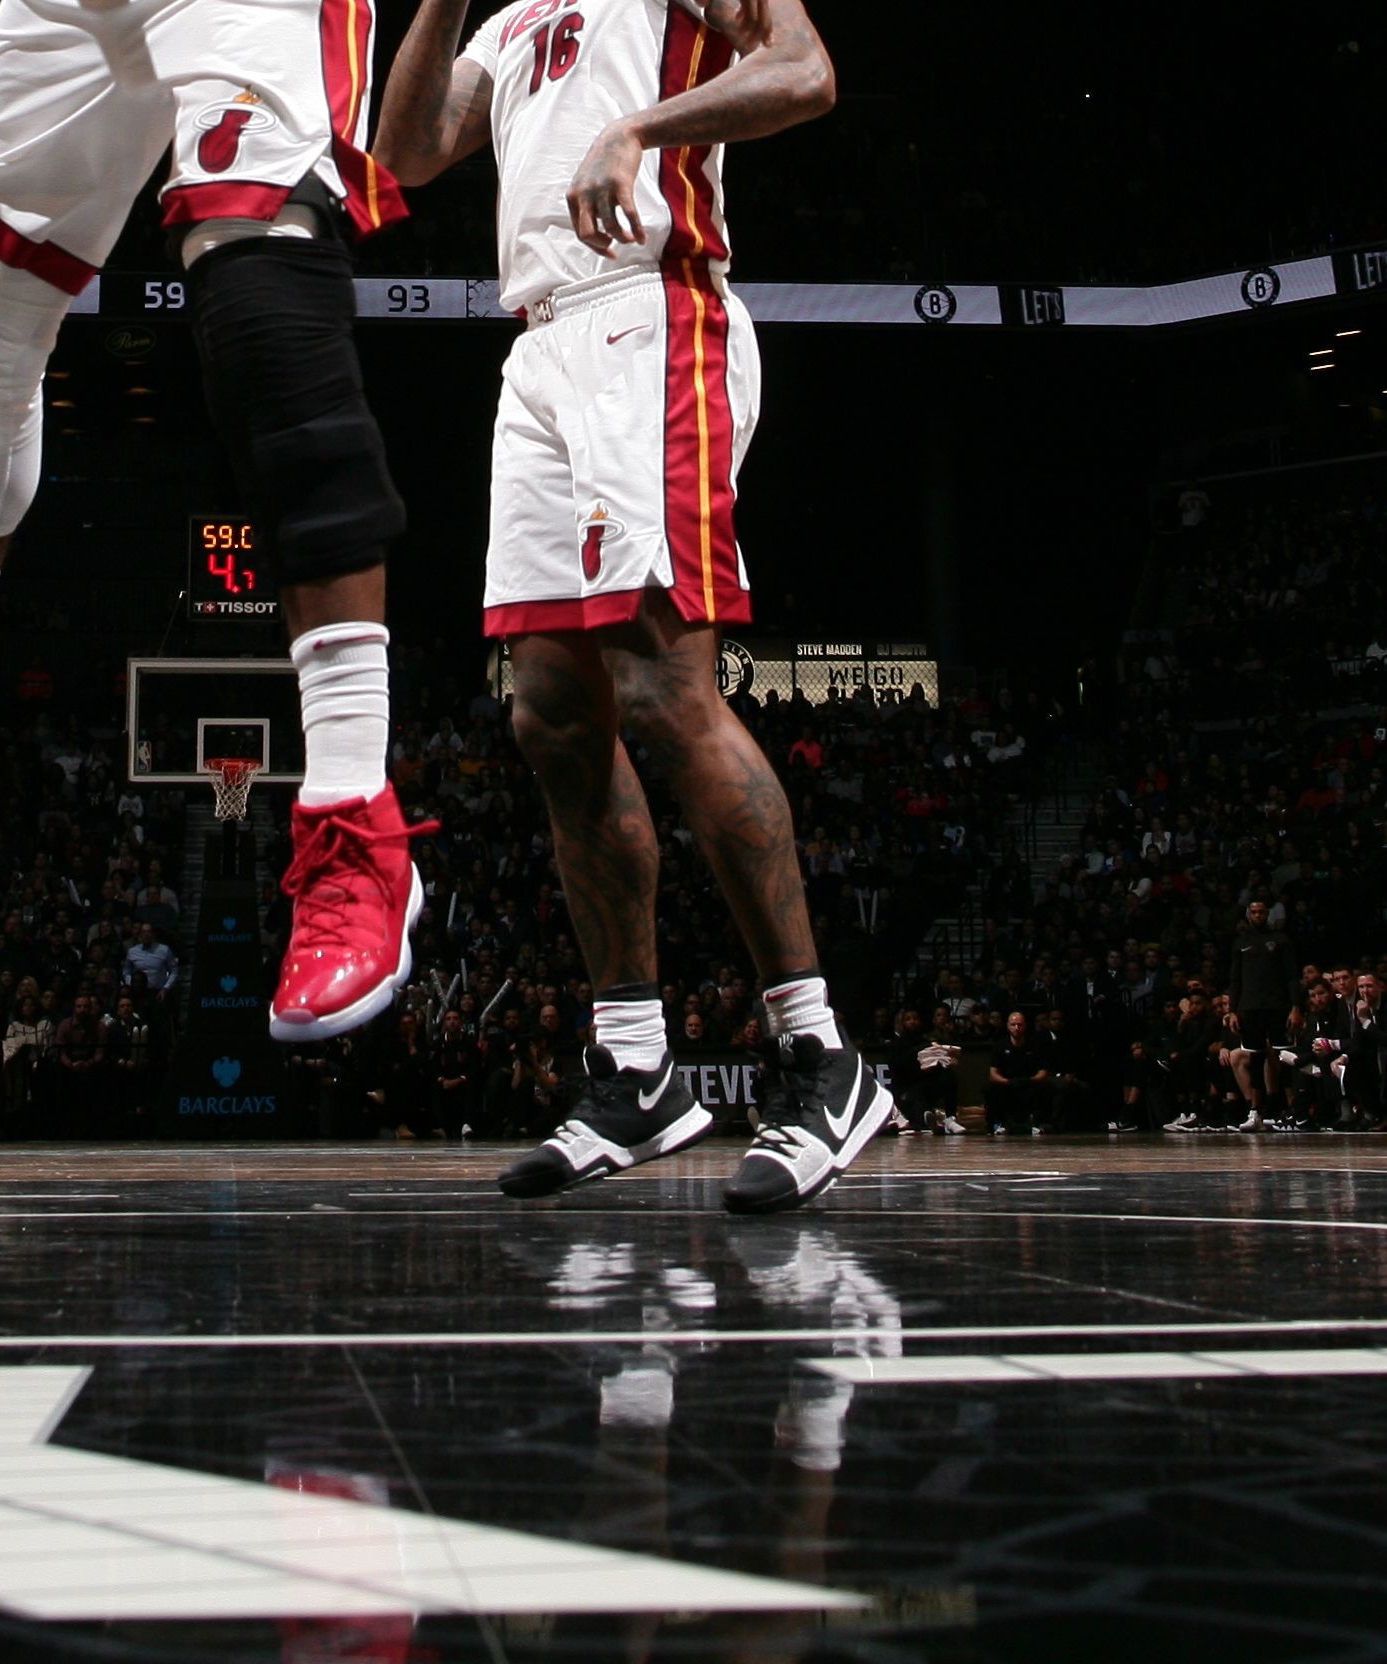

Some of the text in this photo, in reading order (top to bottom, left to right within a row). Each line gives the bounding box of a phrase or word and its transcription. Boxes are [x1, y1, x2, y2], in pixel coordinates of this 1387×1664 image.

[529, 11, 585, 97] 16
[1352, 250, 1387, 291] LET
[142, 280, 186, 310] 59
[387, 284, 431, 313] 93
[217, 602, 277, 614] TISSOT
[796, 643, 824, 656] STEVE
[825, 644, 863, 656] MADDEN
[828, 665, 904, 687] WE GO
[200, 996, 260, 1009] BARCLAYS
[677, 1064, 759, 1105] TEVE
[177, 1095, 277, 1115] BARCLAYS
